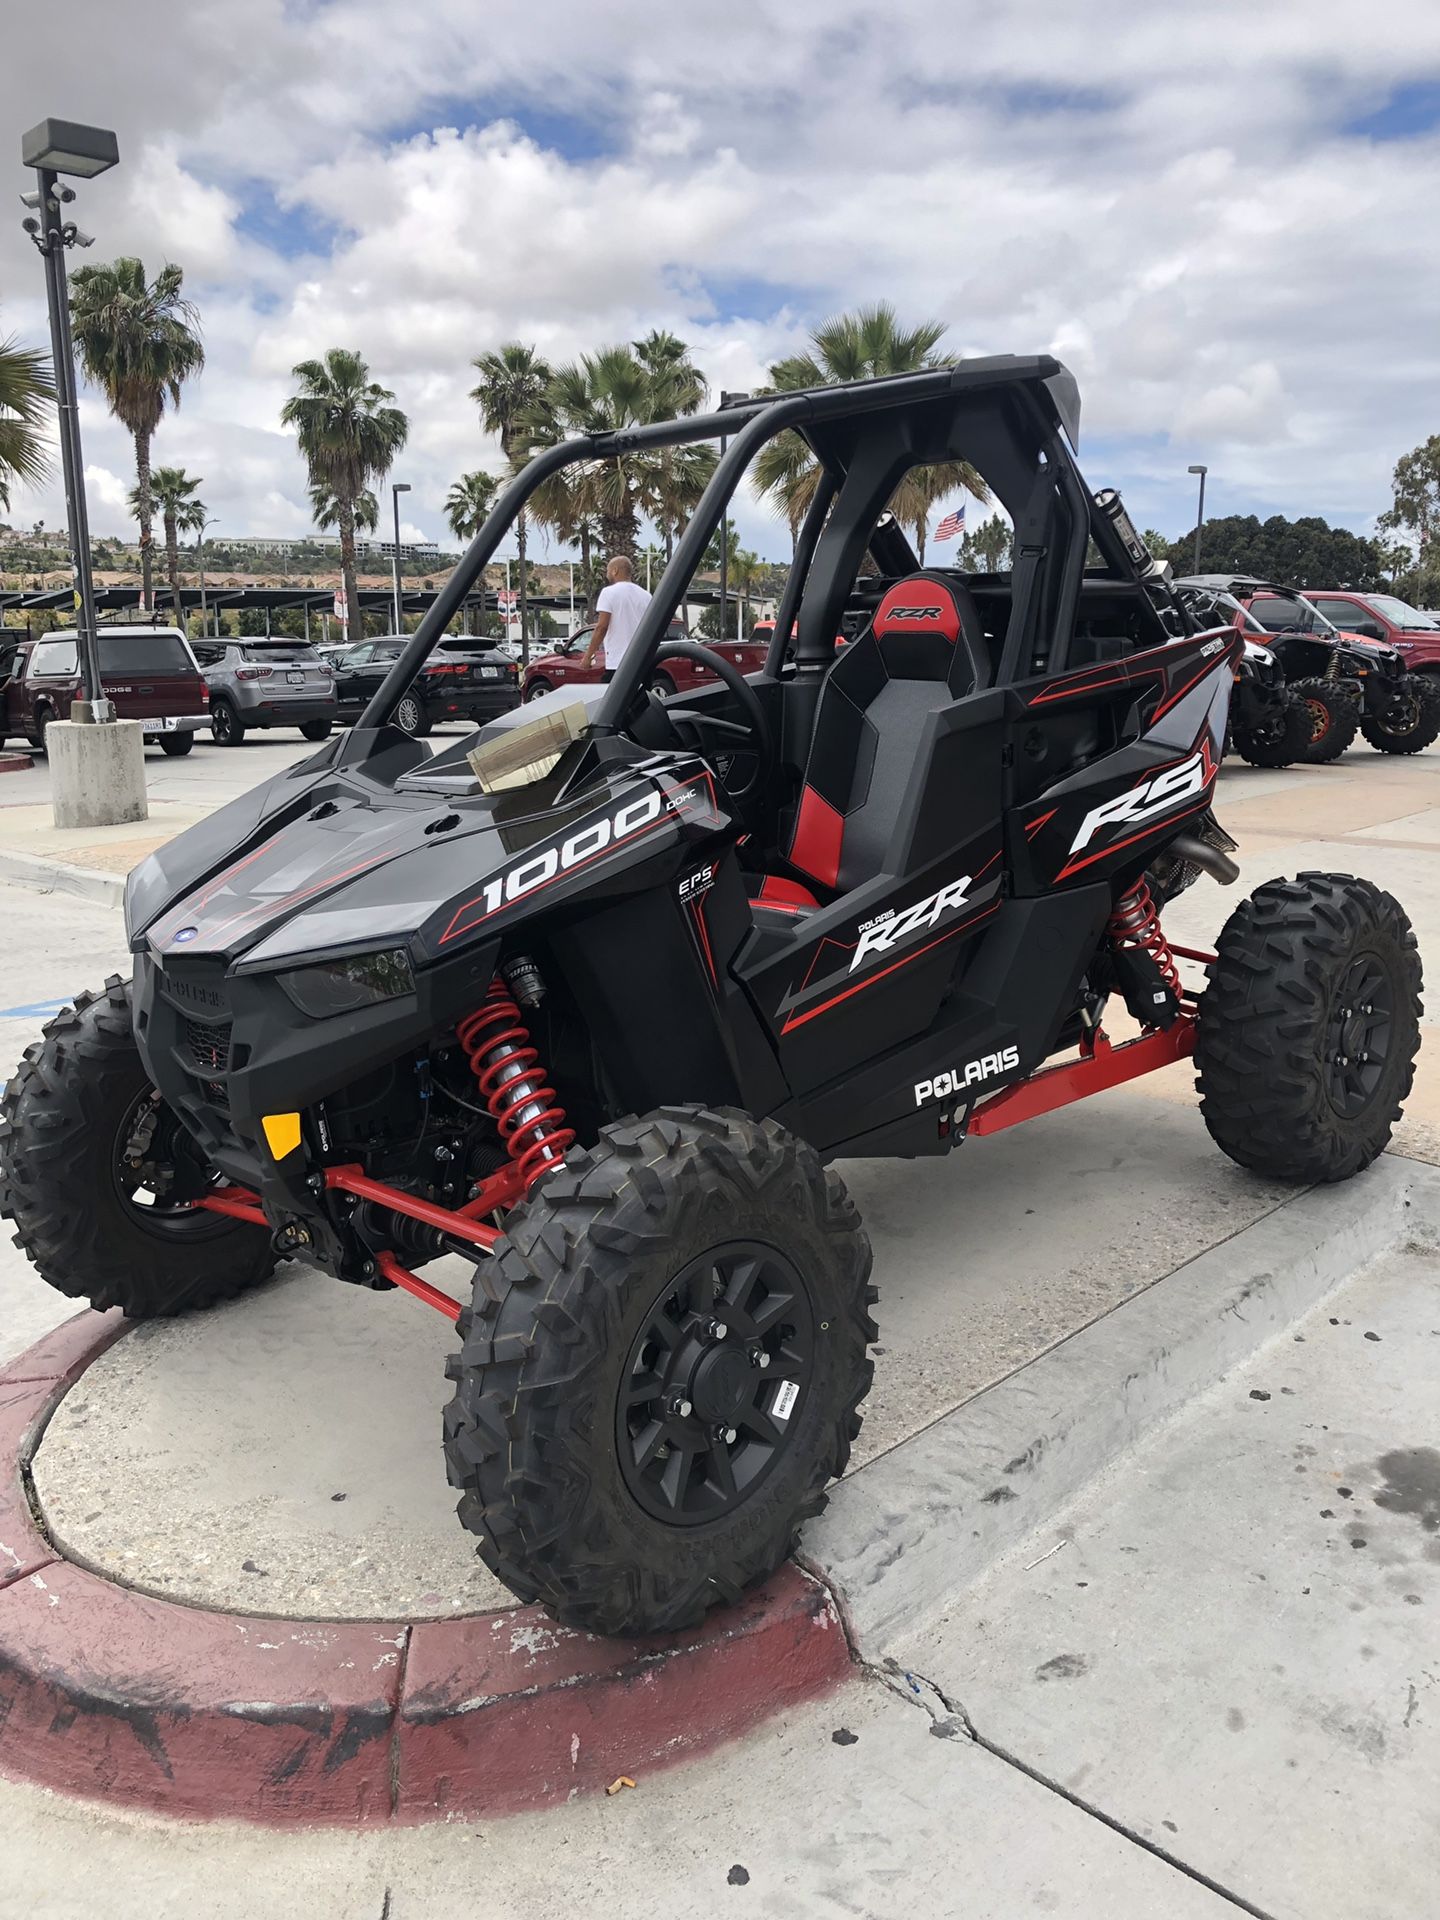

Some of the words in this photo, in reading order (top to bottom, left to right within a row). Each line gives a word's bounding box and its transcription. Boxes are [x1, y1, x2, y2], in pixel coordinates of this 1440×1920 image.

[885, 606, 943, 620] RZR
[666, 789, 697, 811] DOHC
[1068, 737, 1218, 856] RS1
[483, 790, 661, 914] 1000
[679, 866, 712, 895] EPS
[848, 875, 973, 974] RZR
[858, 908, 896, 934] POLARIS
[914, 1045, 1020, 1107] POLARIS
